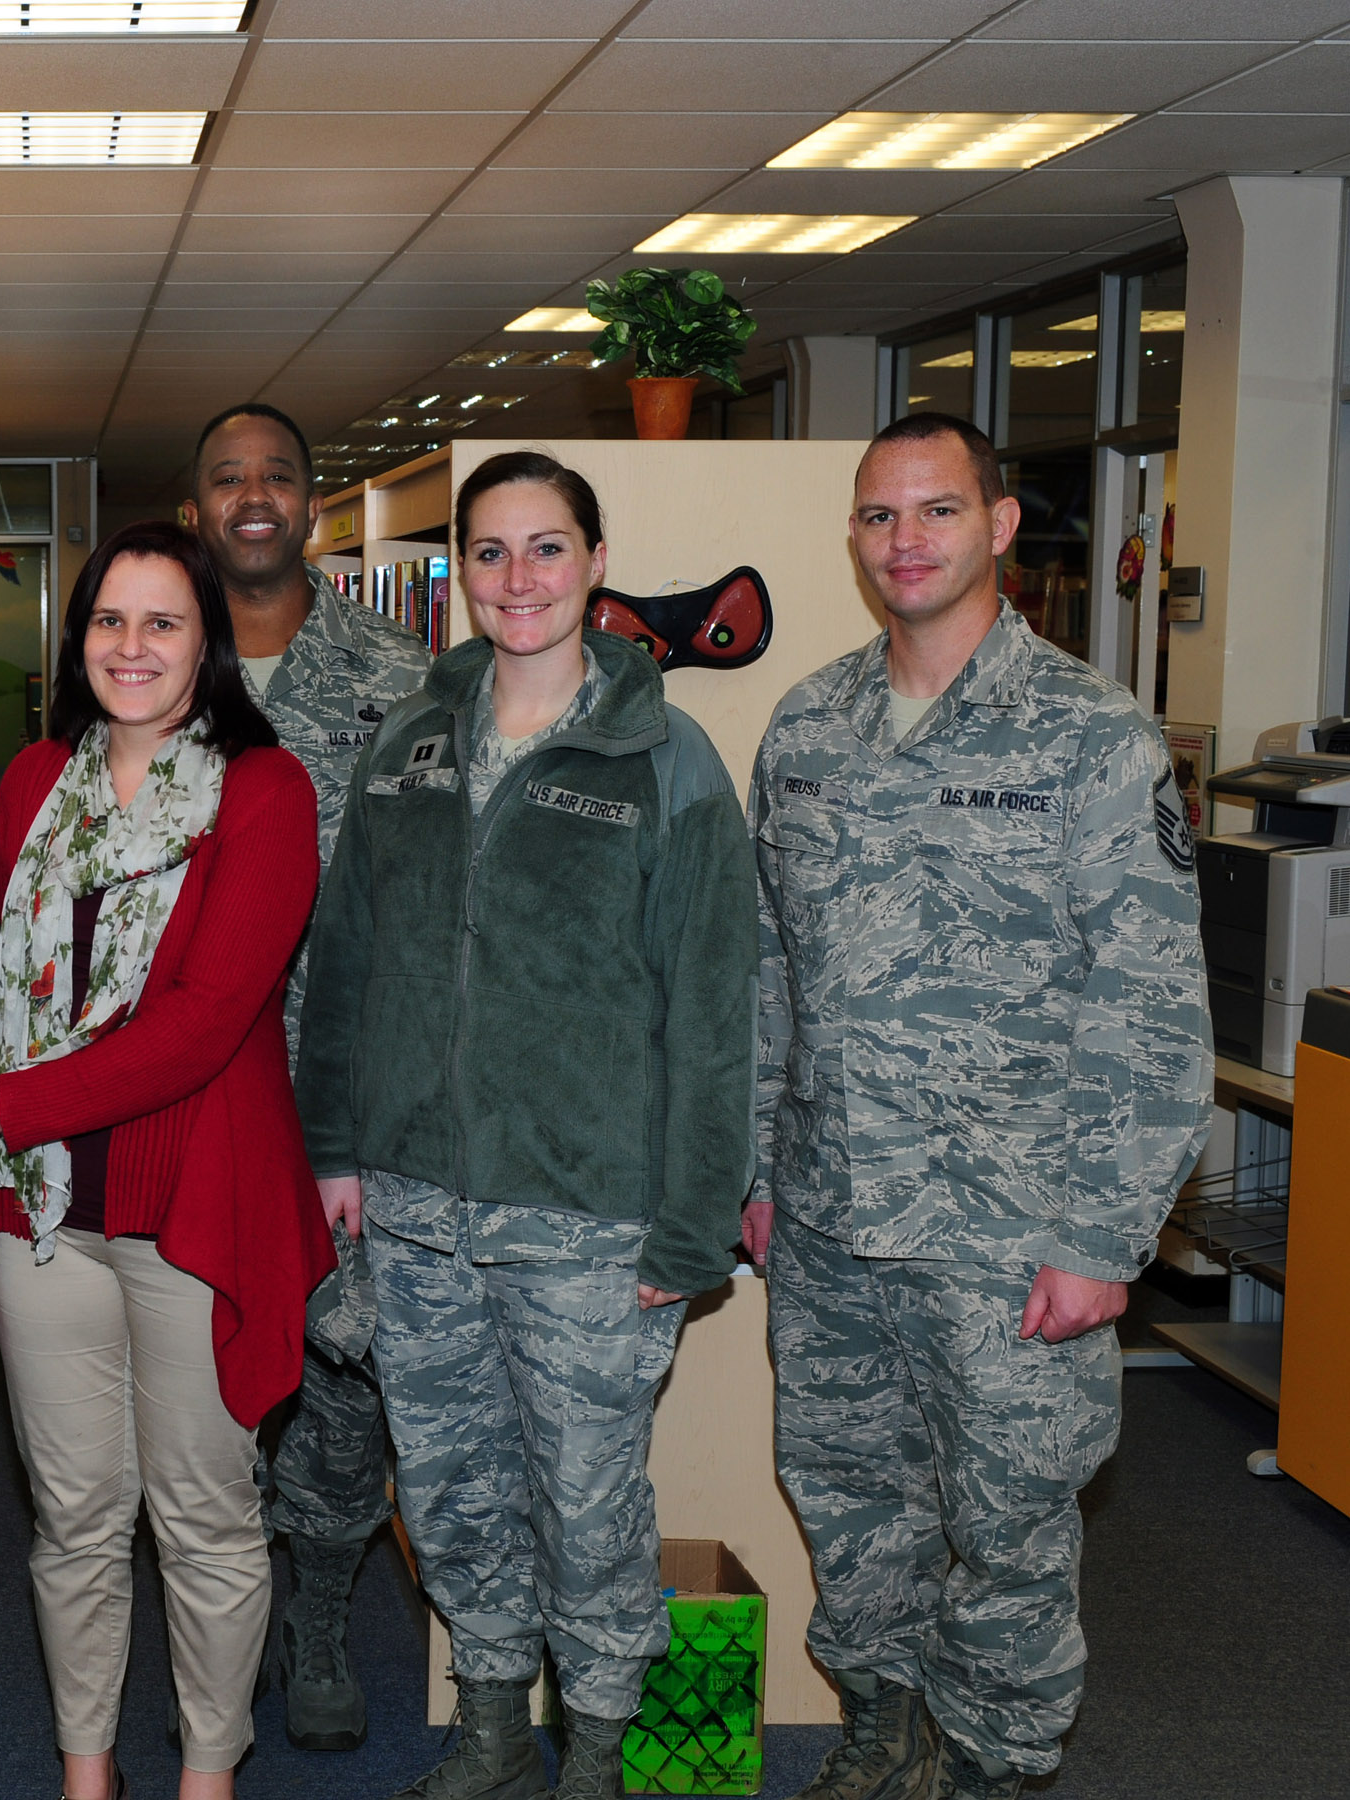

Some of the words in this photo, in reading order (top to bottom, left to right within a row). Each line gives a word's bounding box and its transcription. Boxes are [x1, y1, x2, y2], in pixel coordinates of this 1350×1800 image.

[329, 732, 351, 746] U.S.
[398, 772, 428, 792] KULP
[784, 778, 821, 797] REUSS
[554, 790, 579, 811] AIR
[579, 798, 627, 821] FORCE
[940, 788, 965, 808] U.S.
[968, 790, 995, 809] AIR
[998, 792, 1050, 813] FORCE
[708, 1671, 745, 1680] CREST
